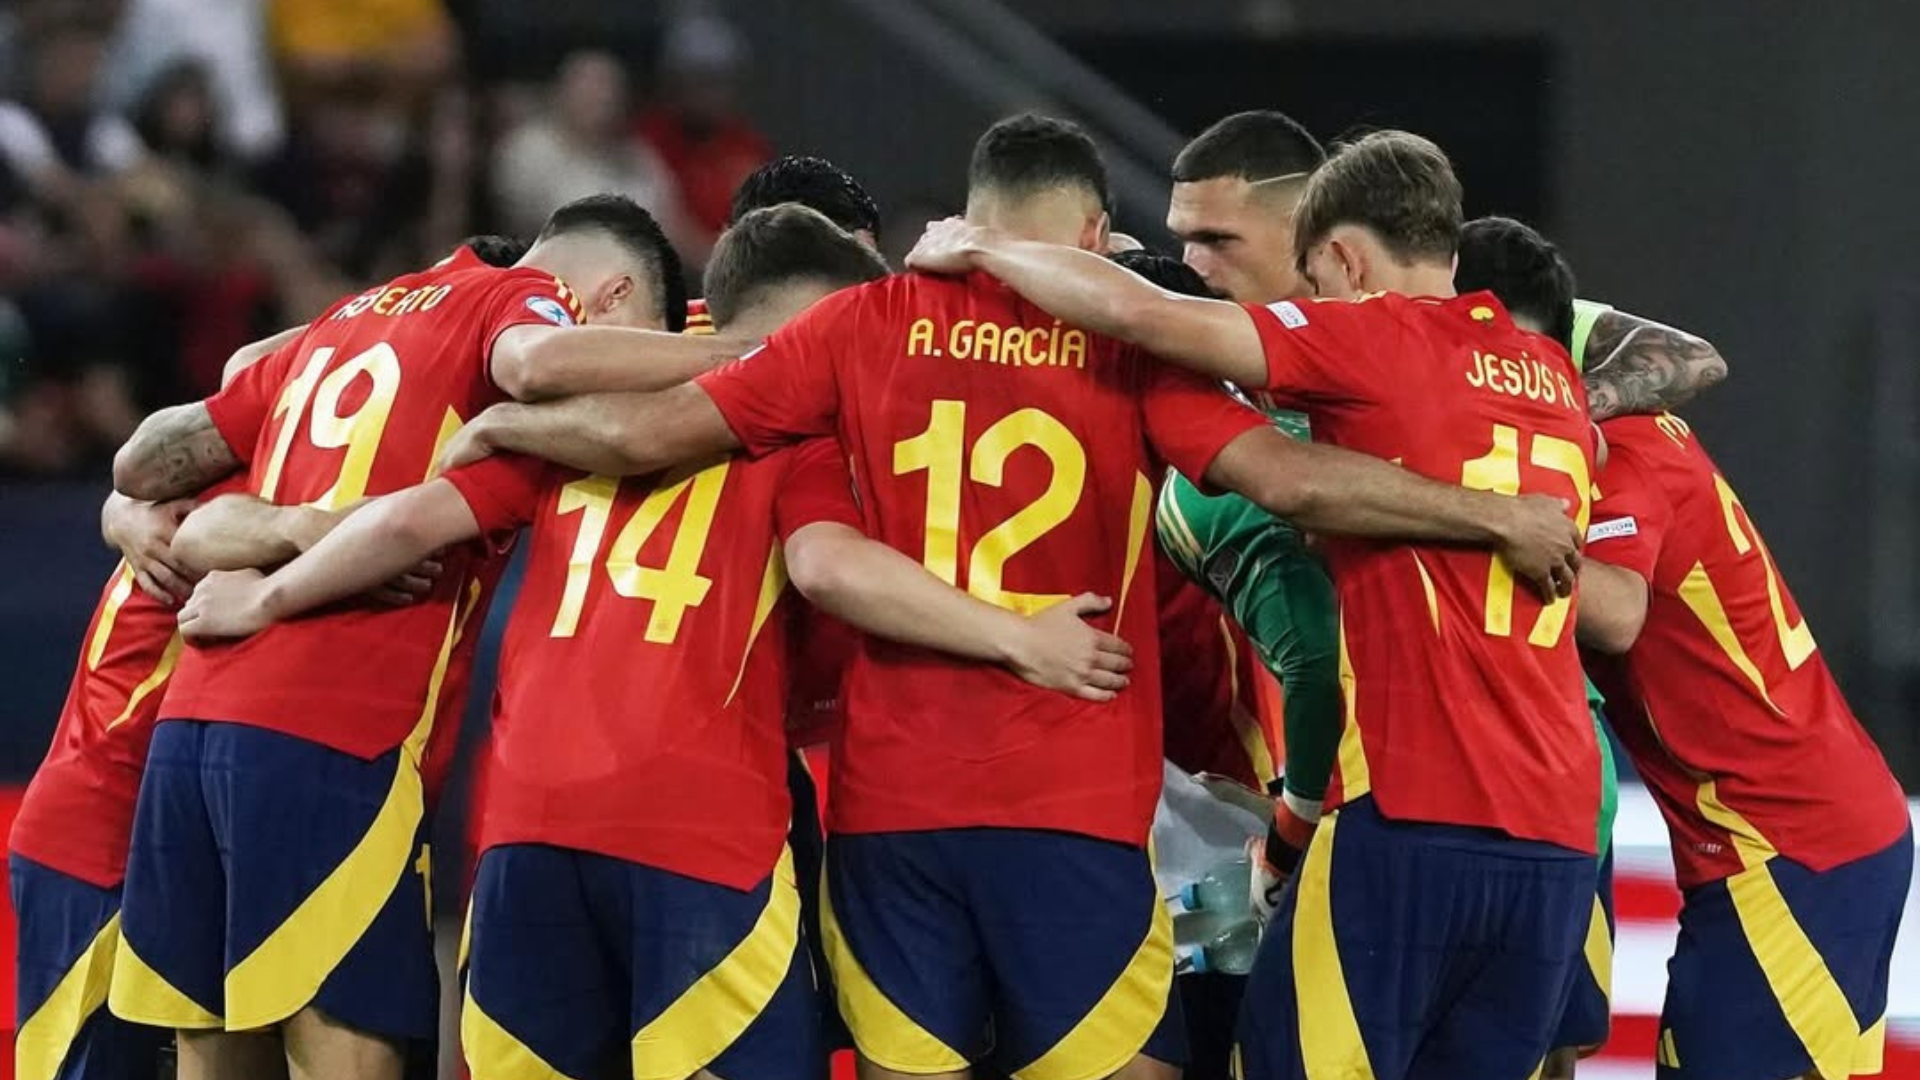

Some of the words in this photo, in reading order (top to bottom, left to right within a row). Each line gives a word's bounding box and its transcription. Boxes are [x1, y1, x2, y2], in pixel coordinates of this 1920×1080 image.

[259, 341, 401, 512] 19
[893, 399, 1087, 617] 12
[550, 463, 731, 645] 14
[1461, 423, 1591, 649] 17
